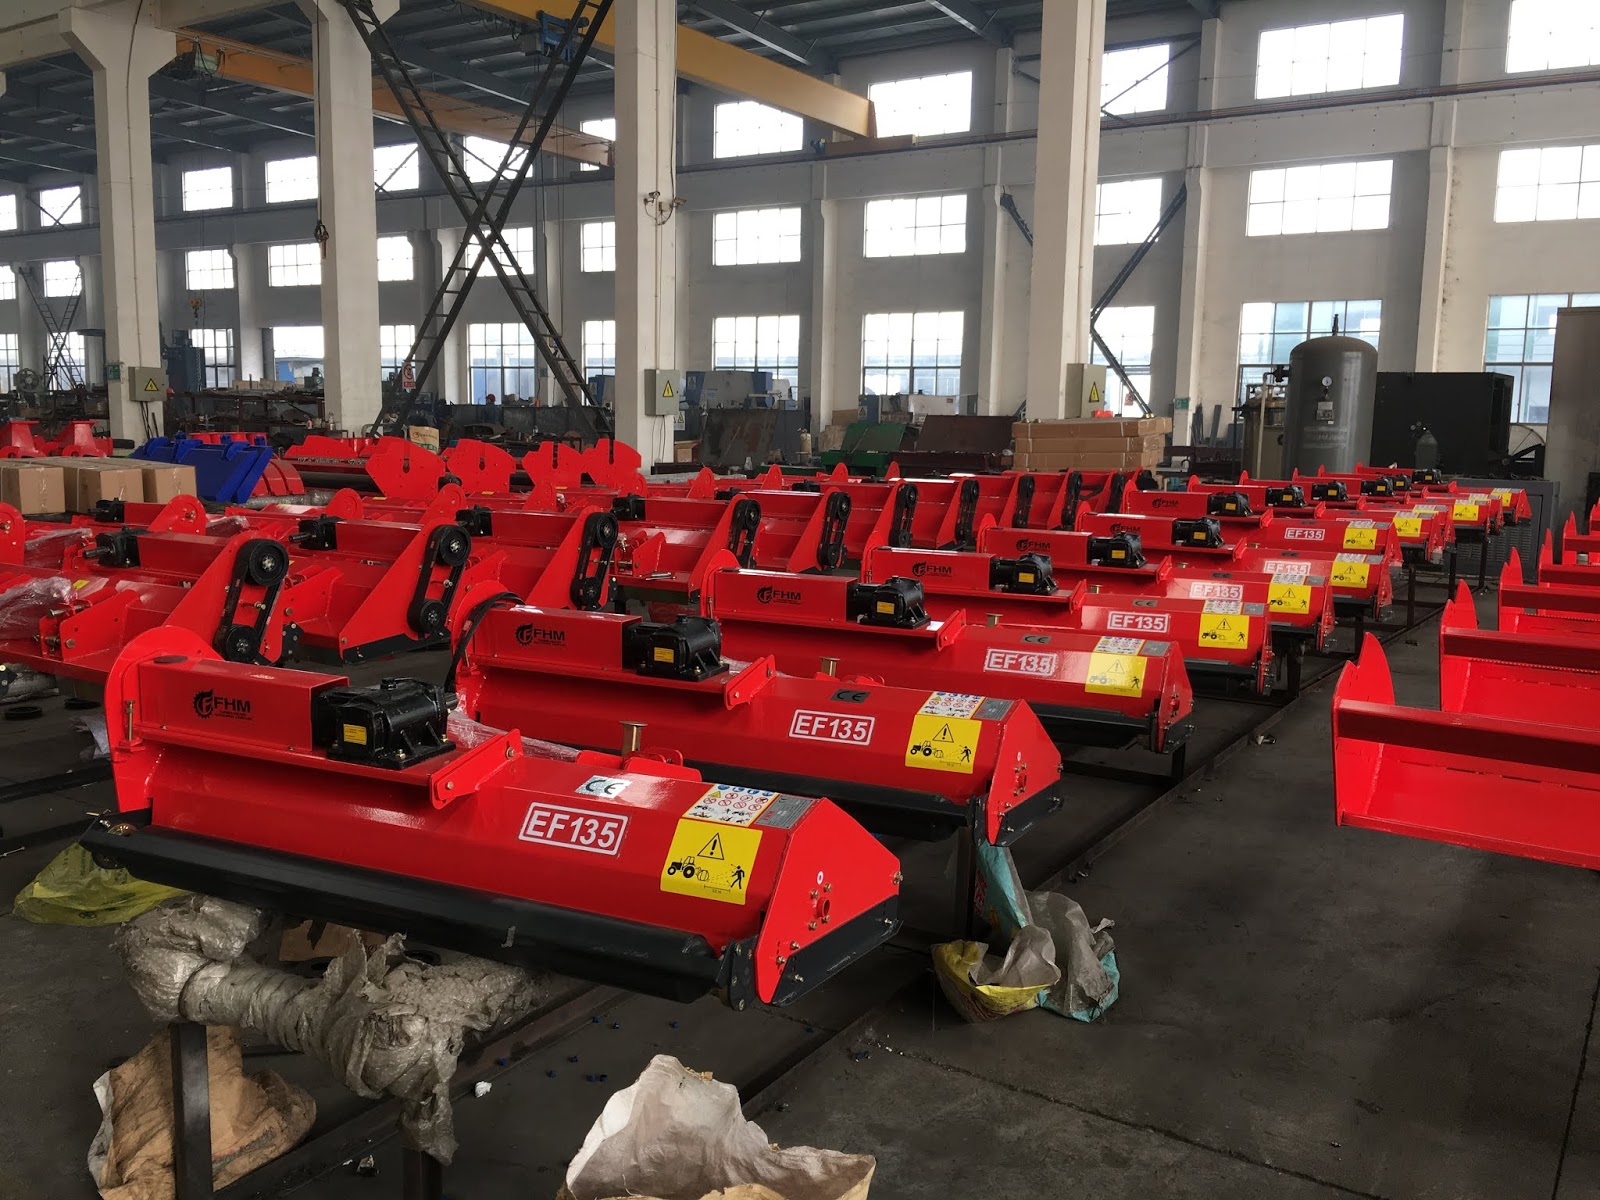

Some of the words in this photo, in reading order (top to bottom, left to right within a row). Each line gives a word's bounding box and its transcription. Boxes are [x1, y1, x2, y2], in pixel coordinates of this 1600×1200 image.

[1286, 529, 1322, 539] EF135
[1029, 541, 1050, 549] FHM
[926, 565, 952, 574] FHM
[1267, 563, 1307, 575] EF135
[773, 590, 801, 600] FHM
[1193, 584, 1239, 598] EF135
[1111, 614, 1164, 630] EF135
[533, 628, 565, 641] FHM
[989, 652, 1052, 673] EF135
[213, 696, 251, 713] FHM
[794, 714, 868, 741] EF135
[525, 809, 619, 848] EF135
